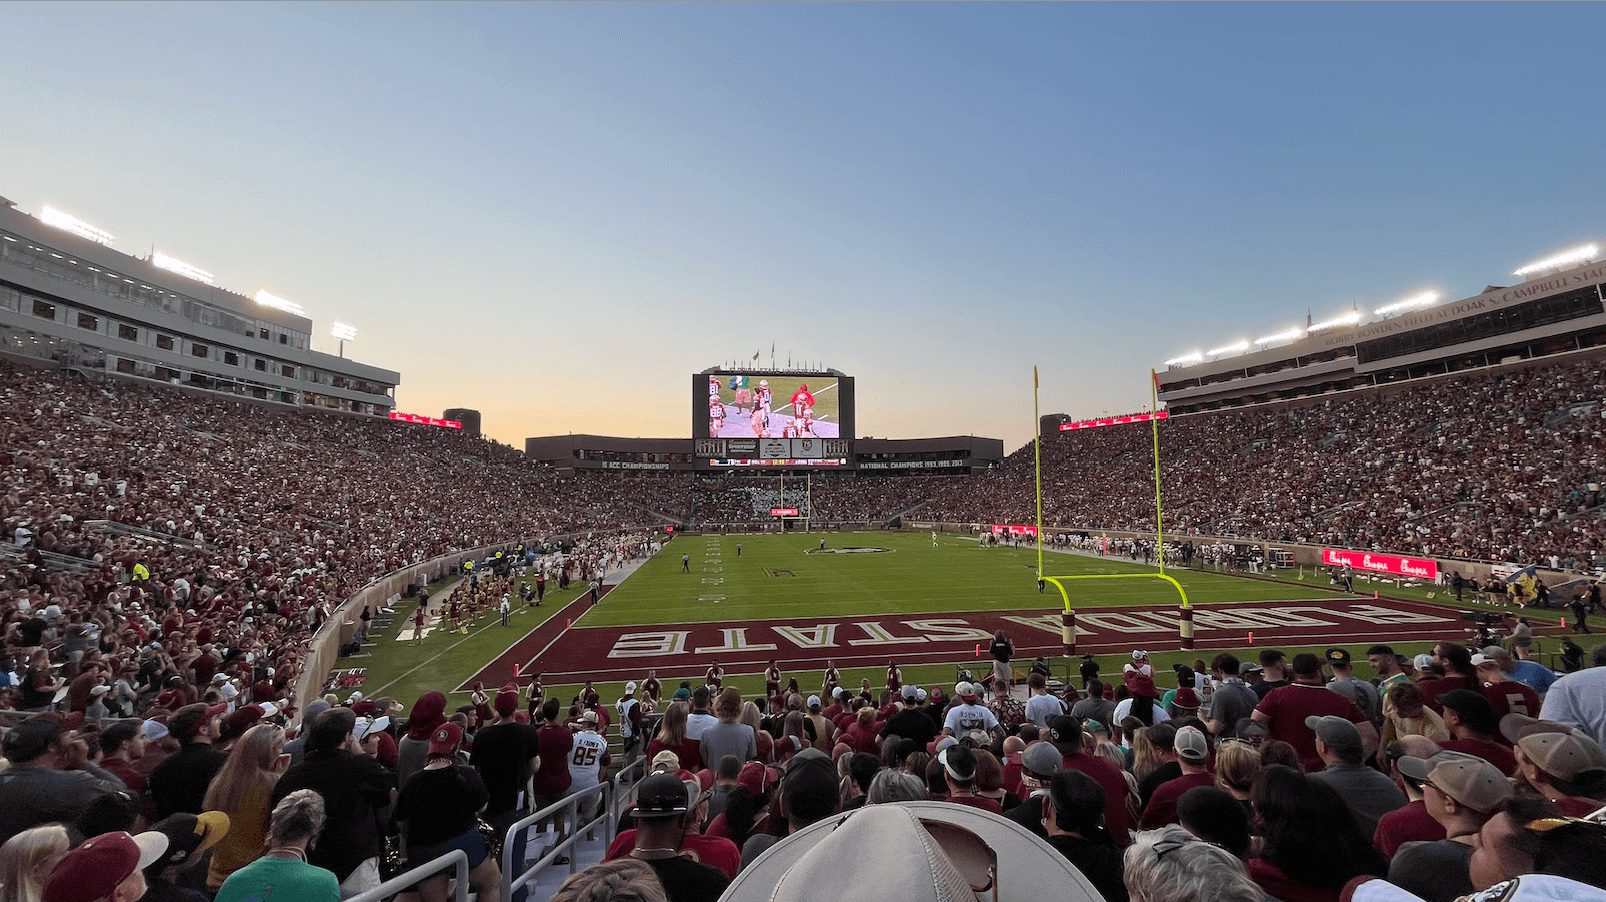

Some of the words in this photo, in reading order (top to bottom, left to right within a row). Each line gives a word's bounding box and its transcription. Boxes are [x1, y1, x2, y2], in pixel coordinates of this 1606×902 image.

[1325, 333, 1354, 346] BOBBY
[1357, 322, 1401, 339] BOWDEN
[1404, 313, 1433, 327] FIELD
[1452, 299, 1486, 315] DOAK
[1502, 277, 1570, 302] CAMPBELL
[622, 461, 670, 470] CHAMPIONSHIPS
[890, 461, 923, 469] CHAMPIONS
[1004, 604, 1458, 636] FLORIDA
[606, 618, 998, 659] STATE
[574, 746, 598, 766] 85
